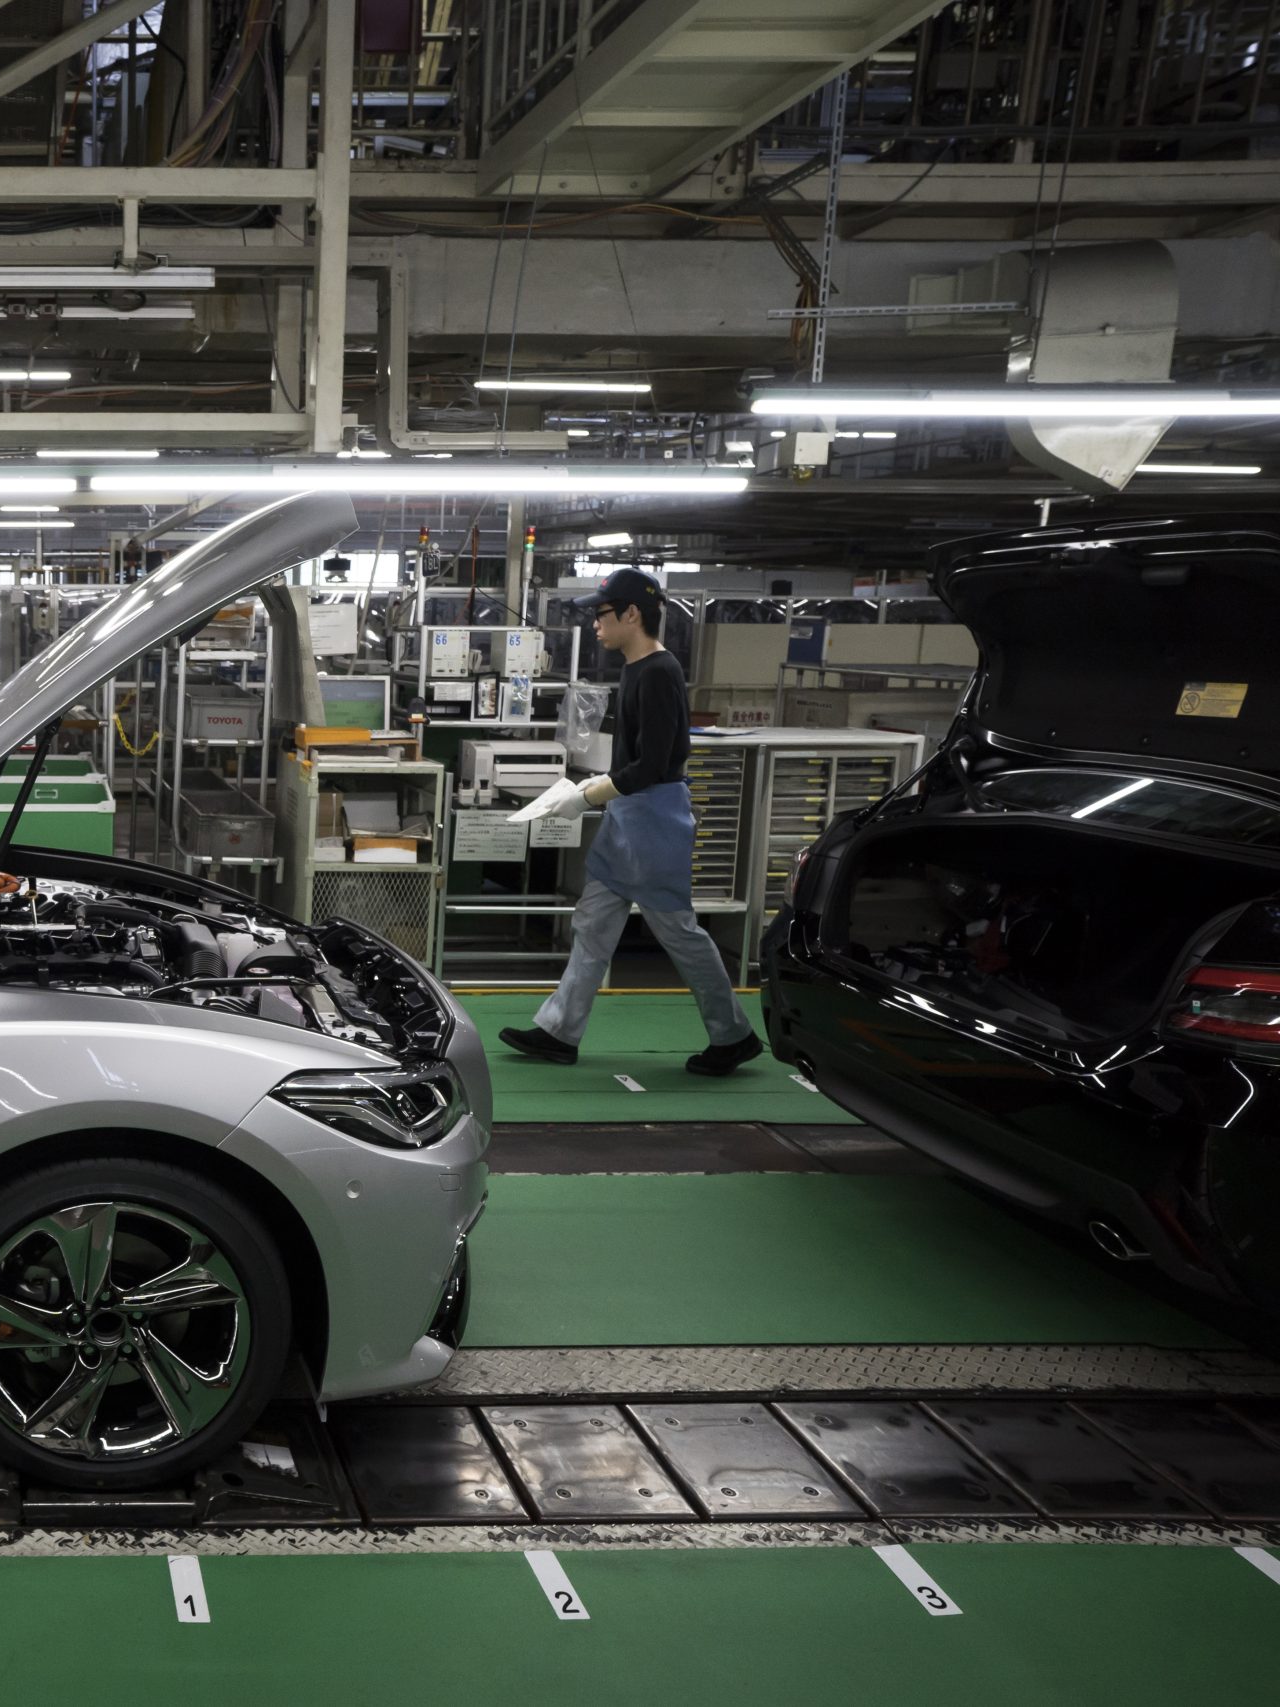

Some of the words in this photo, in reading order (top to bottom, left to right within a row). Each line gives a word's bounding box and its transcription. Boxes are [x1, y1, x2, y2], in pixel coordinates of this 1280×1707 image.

[435, 634, 448, 646] 66
[509, 633, 521, 647] 65
[207, 716, 243, 726] TOYOTA
[183, 1595, 197, 1617] 1
[554, 1591, 580, 1614] 2
[917, 1586, 948, 1609] 3
